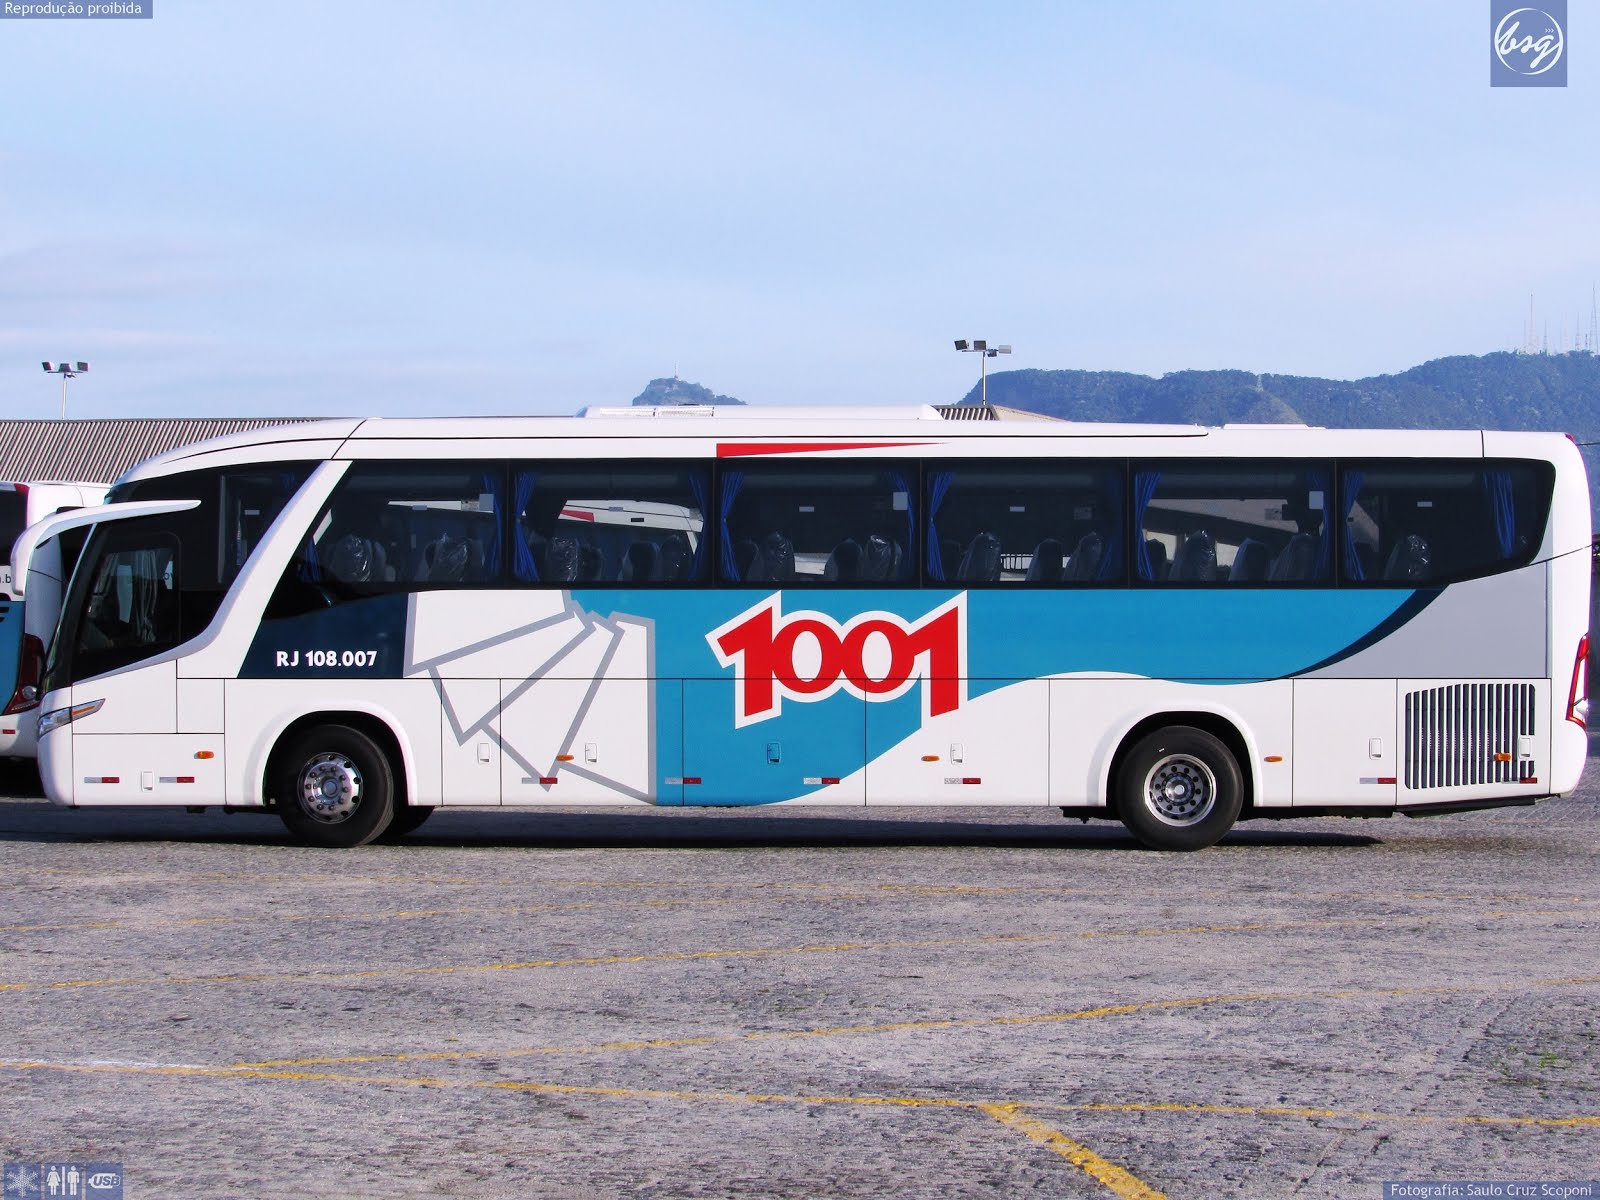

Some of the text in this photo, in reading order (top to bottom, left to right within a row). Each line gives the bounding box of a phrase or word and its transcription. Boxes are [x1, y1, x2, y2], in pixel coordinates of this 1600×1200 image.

[276, 650, 378, 667] RJ 108.007
[710, 597, 964, 722] 1001
